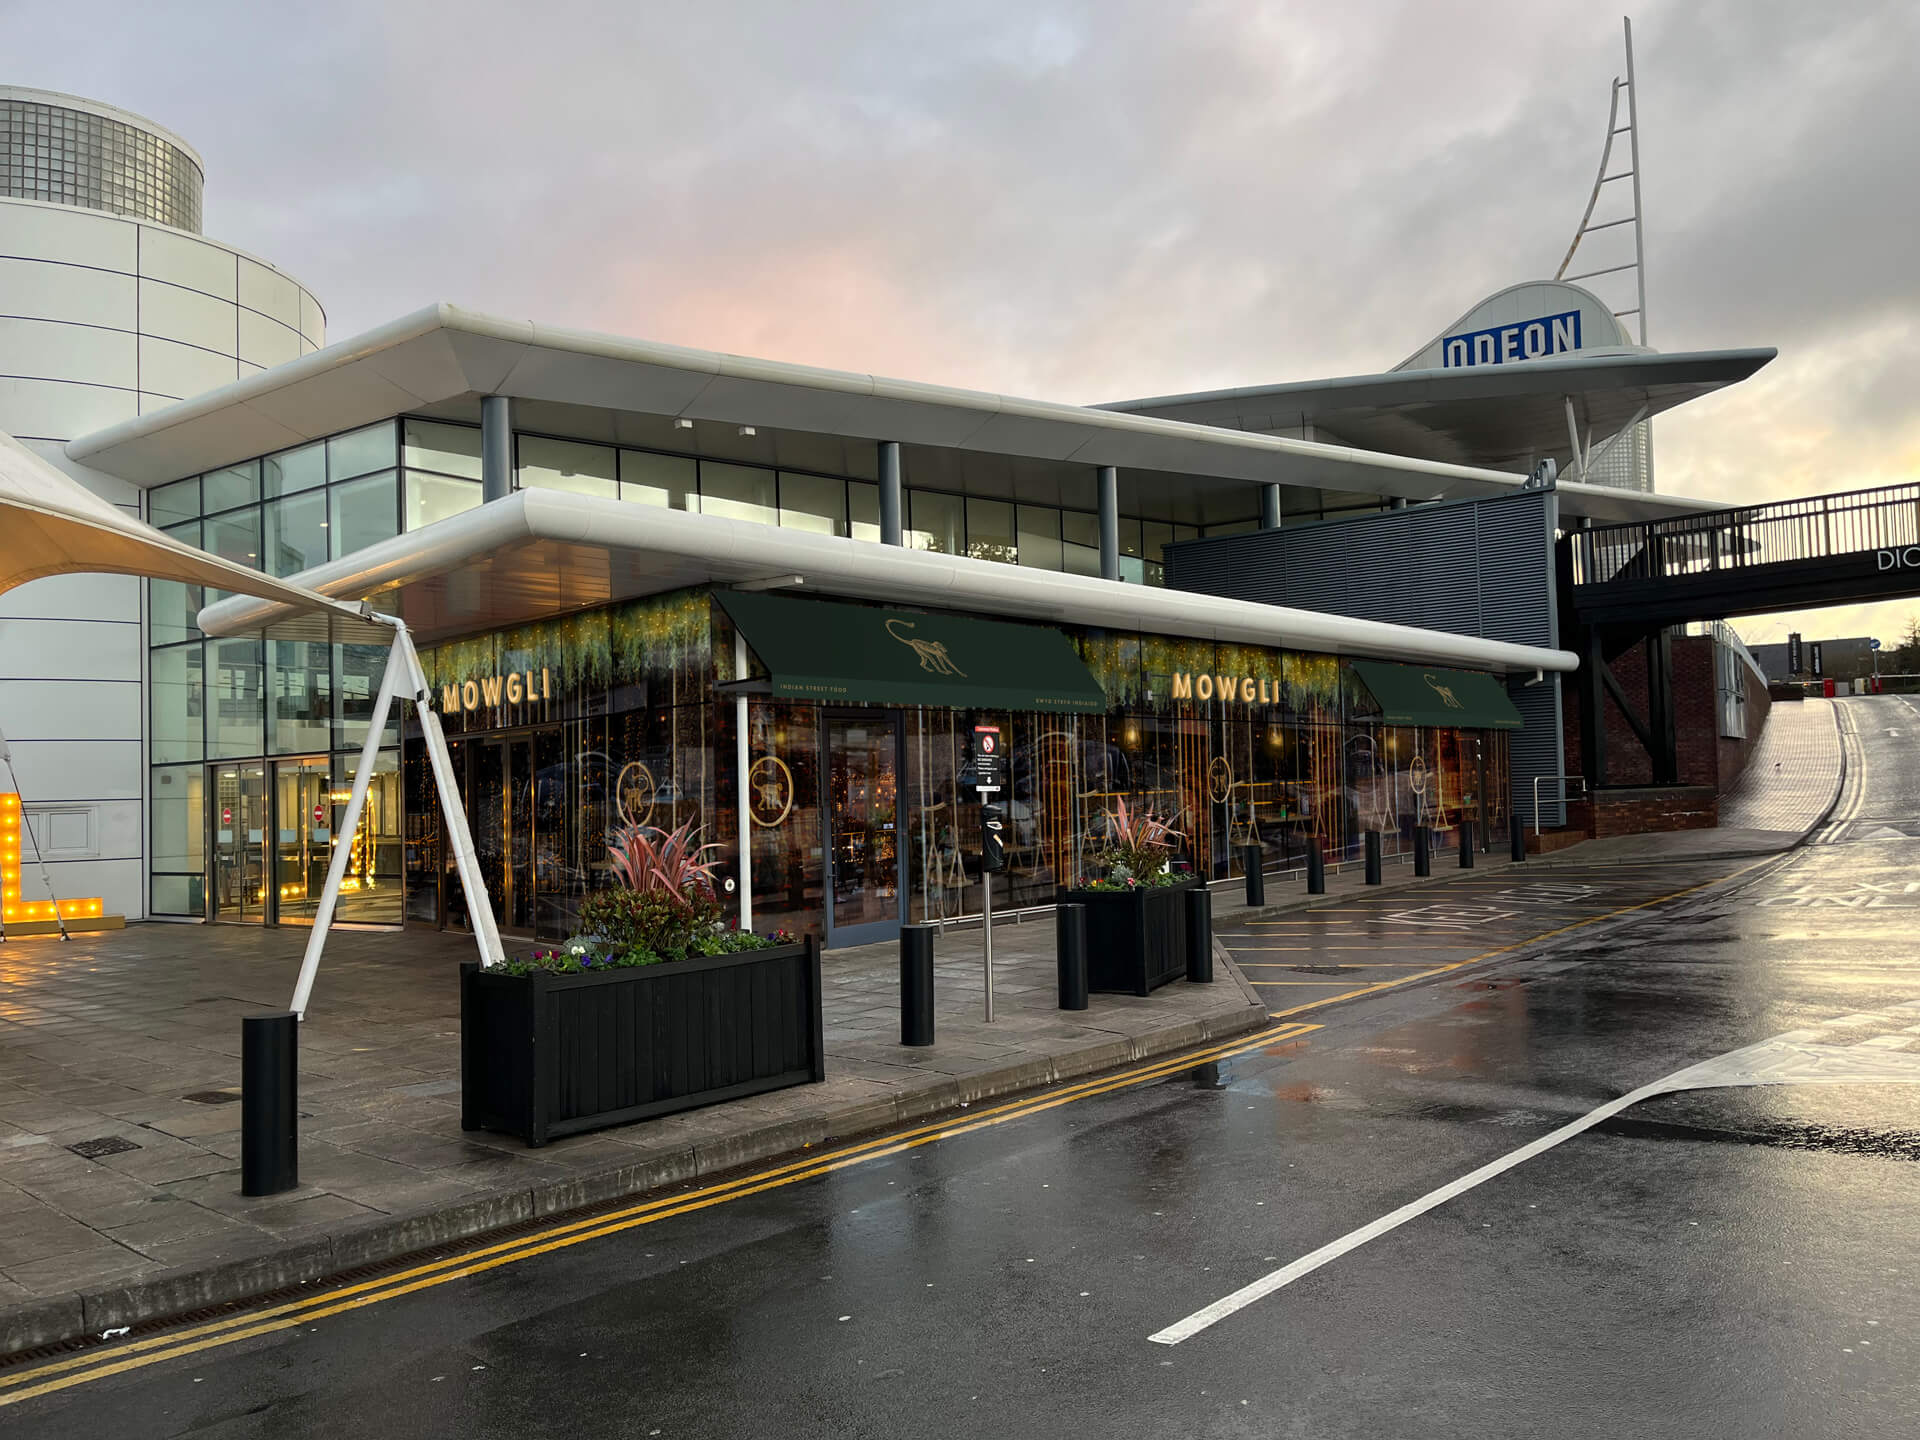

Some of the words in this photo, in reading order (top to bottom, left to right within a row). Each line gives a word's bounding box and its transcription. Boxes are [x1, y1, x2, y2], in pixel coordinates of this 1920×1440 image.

[1447, 315, 1576, 368] ODEON
[443, 667, 550, 714] MOWGLI
[1171, 671, 1280, 705] MOWGLI
